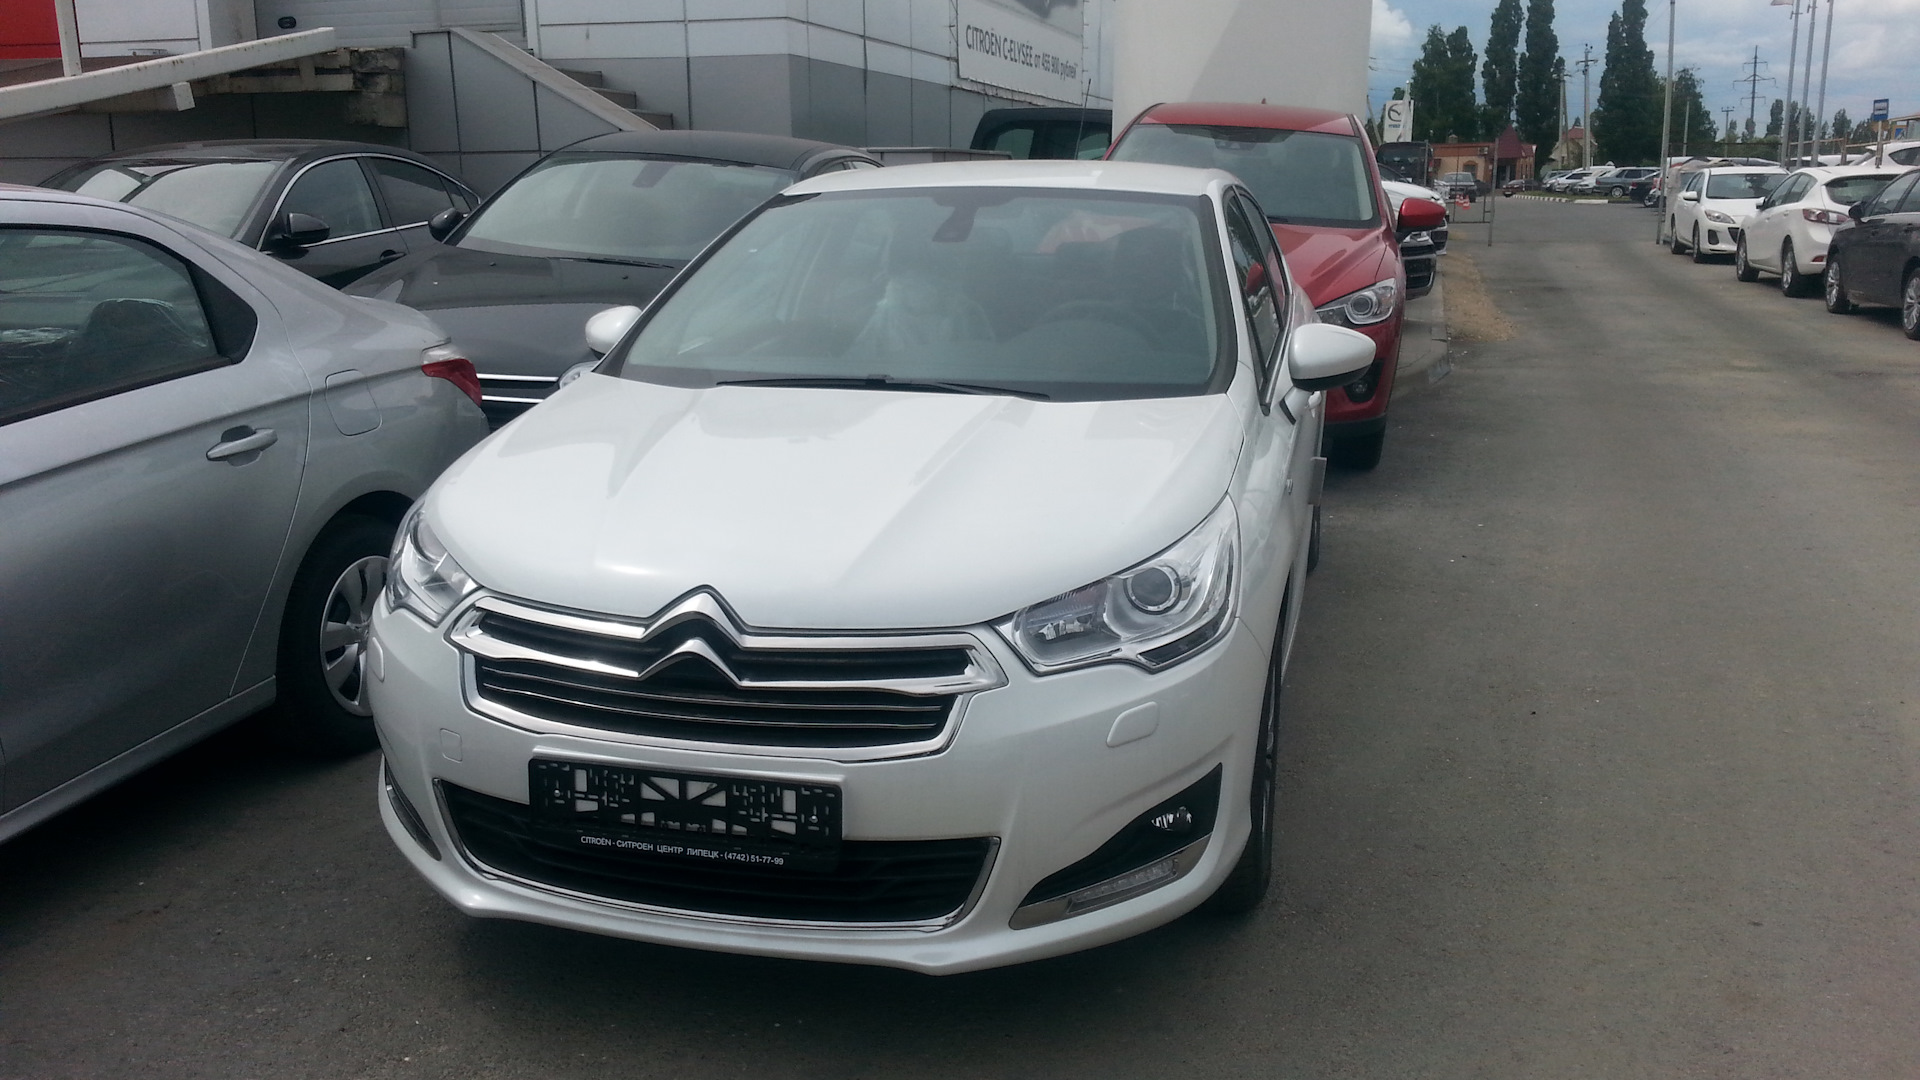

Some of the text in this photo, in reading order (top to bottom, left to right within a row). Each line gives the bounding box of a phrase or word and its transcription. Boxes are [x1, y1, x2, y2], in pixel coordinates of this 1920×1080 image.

[965, 24, 1001, 58] CITROËN
[1002, 37, 1033, 68] C-ELYSÉE
[580, 836, 612, 846] CITROËN
[616, 839, 653, 851] СИТРОЕН
[656, 844, 683, 854] ЦЕНТР
[686, 846, 719, 859] ЛИПЕЦК
[724, 851, 750, 862] (4742)
[750, 854, 784, 865] 51-77-99
